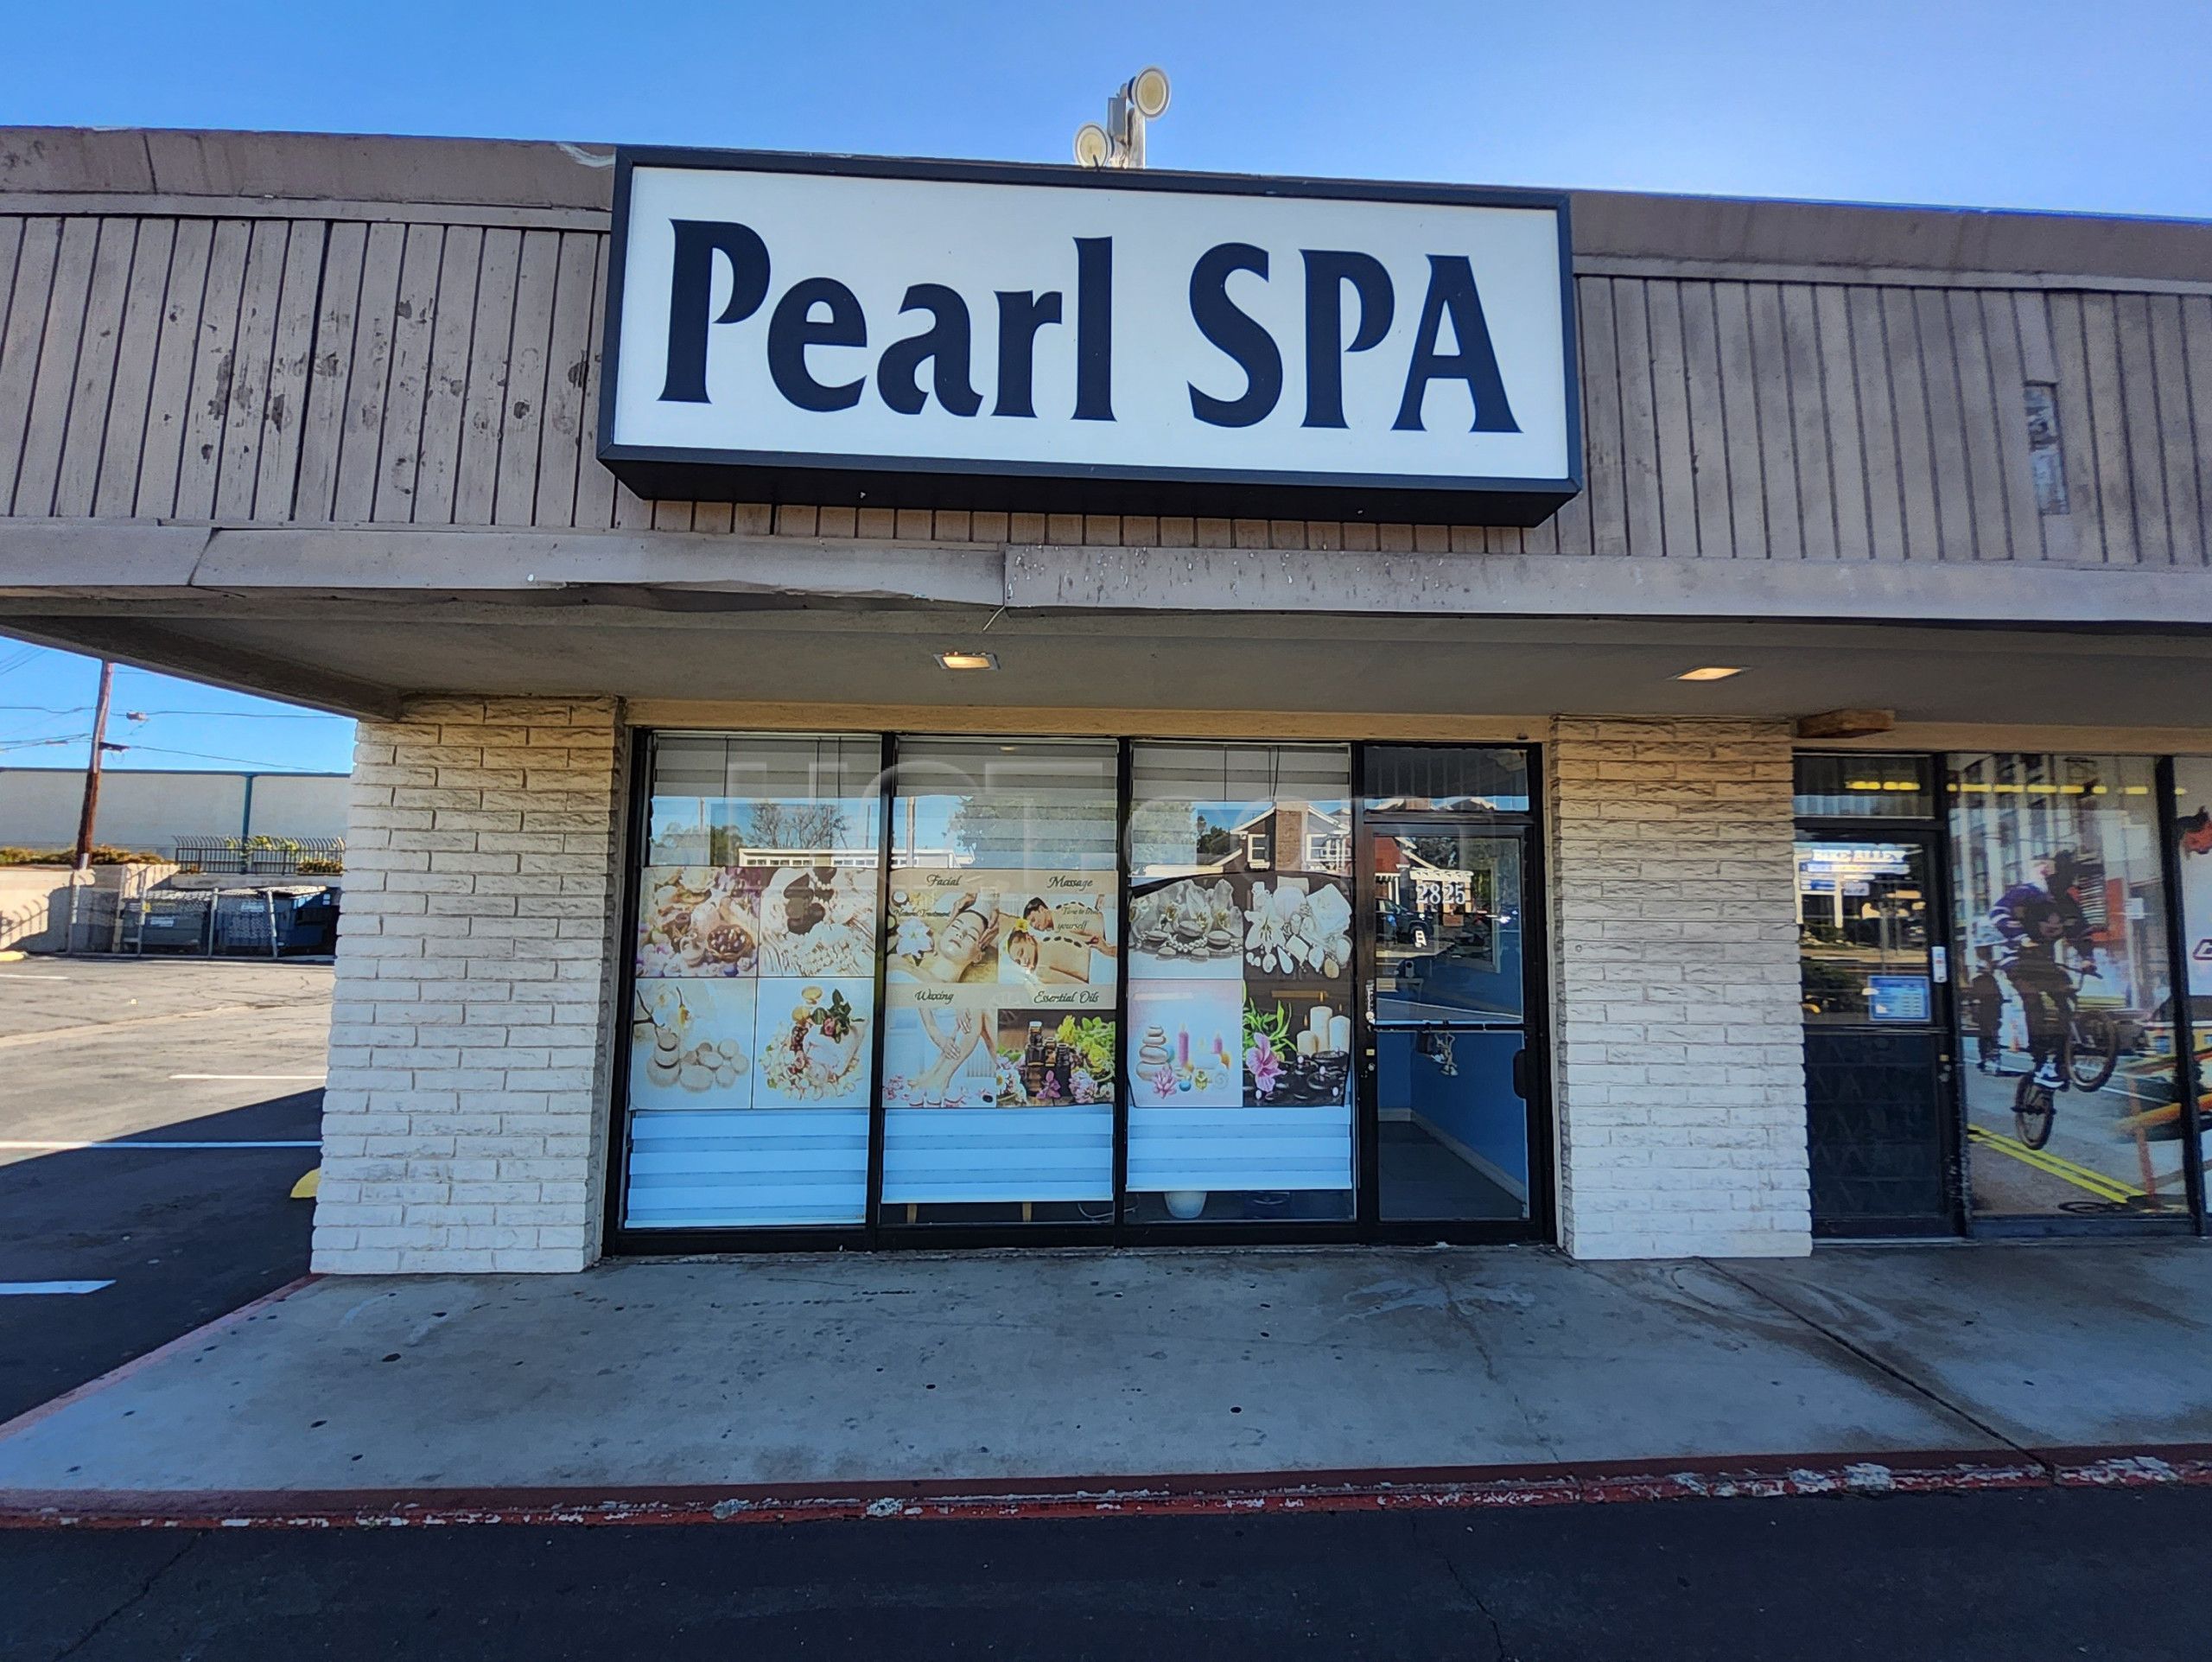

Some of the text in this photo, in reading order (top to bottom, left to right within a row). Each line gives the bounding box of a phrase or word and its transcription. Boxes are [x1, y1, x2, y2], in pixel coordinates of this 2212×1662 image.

[658, 219, 1522, 433] Pearl SPA
[926, 874, 963, 887] Facial
[1046, 875, 1093, 891] Massage
[1415, 883, 1466, 905] 2825
[1055, 920, 1089, 933] yourself
[914, 988, 954, 1005] Waxing
[1033, 990, 1099, 1003] Essential Oils
